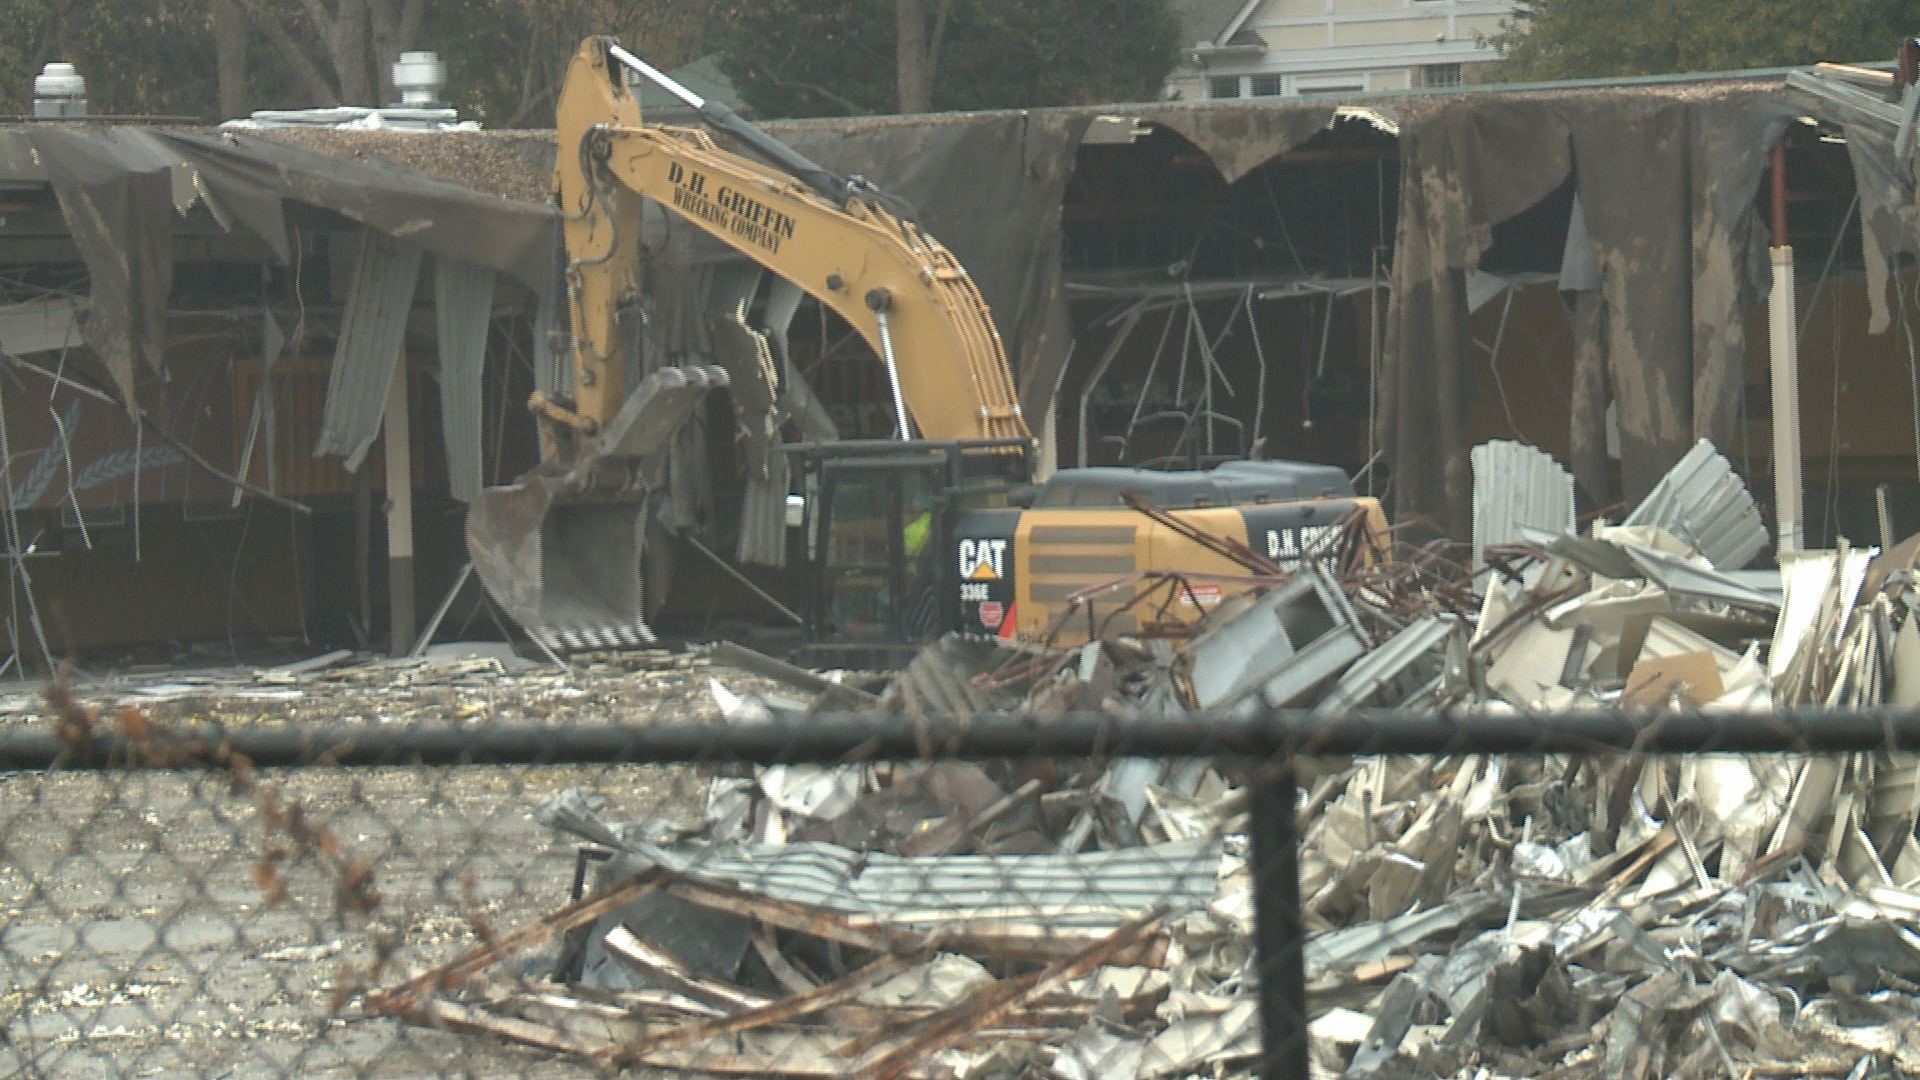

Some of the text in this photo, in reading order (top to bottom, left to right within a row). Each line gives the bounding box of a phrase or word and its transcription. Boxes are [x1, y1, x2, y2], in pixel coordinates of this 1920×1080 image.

[668, 161, 796, 240] D.H. GRIFFIN
[674, 187, 780, 255] WRECKING COMPANY
[959, 538, 1007, 579] CAT
[1266, 529, 1300, 558] D.H.
[960, 583, 989, 601] 336E
